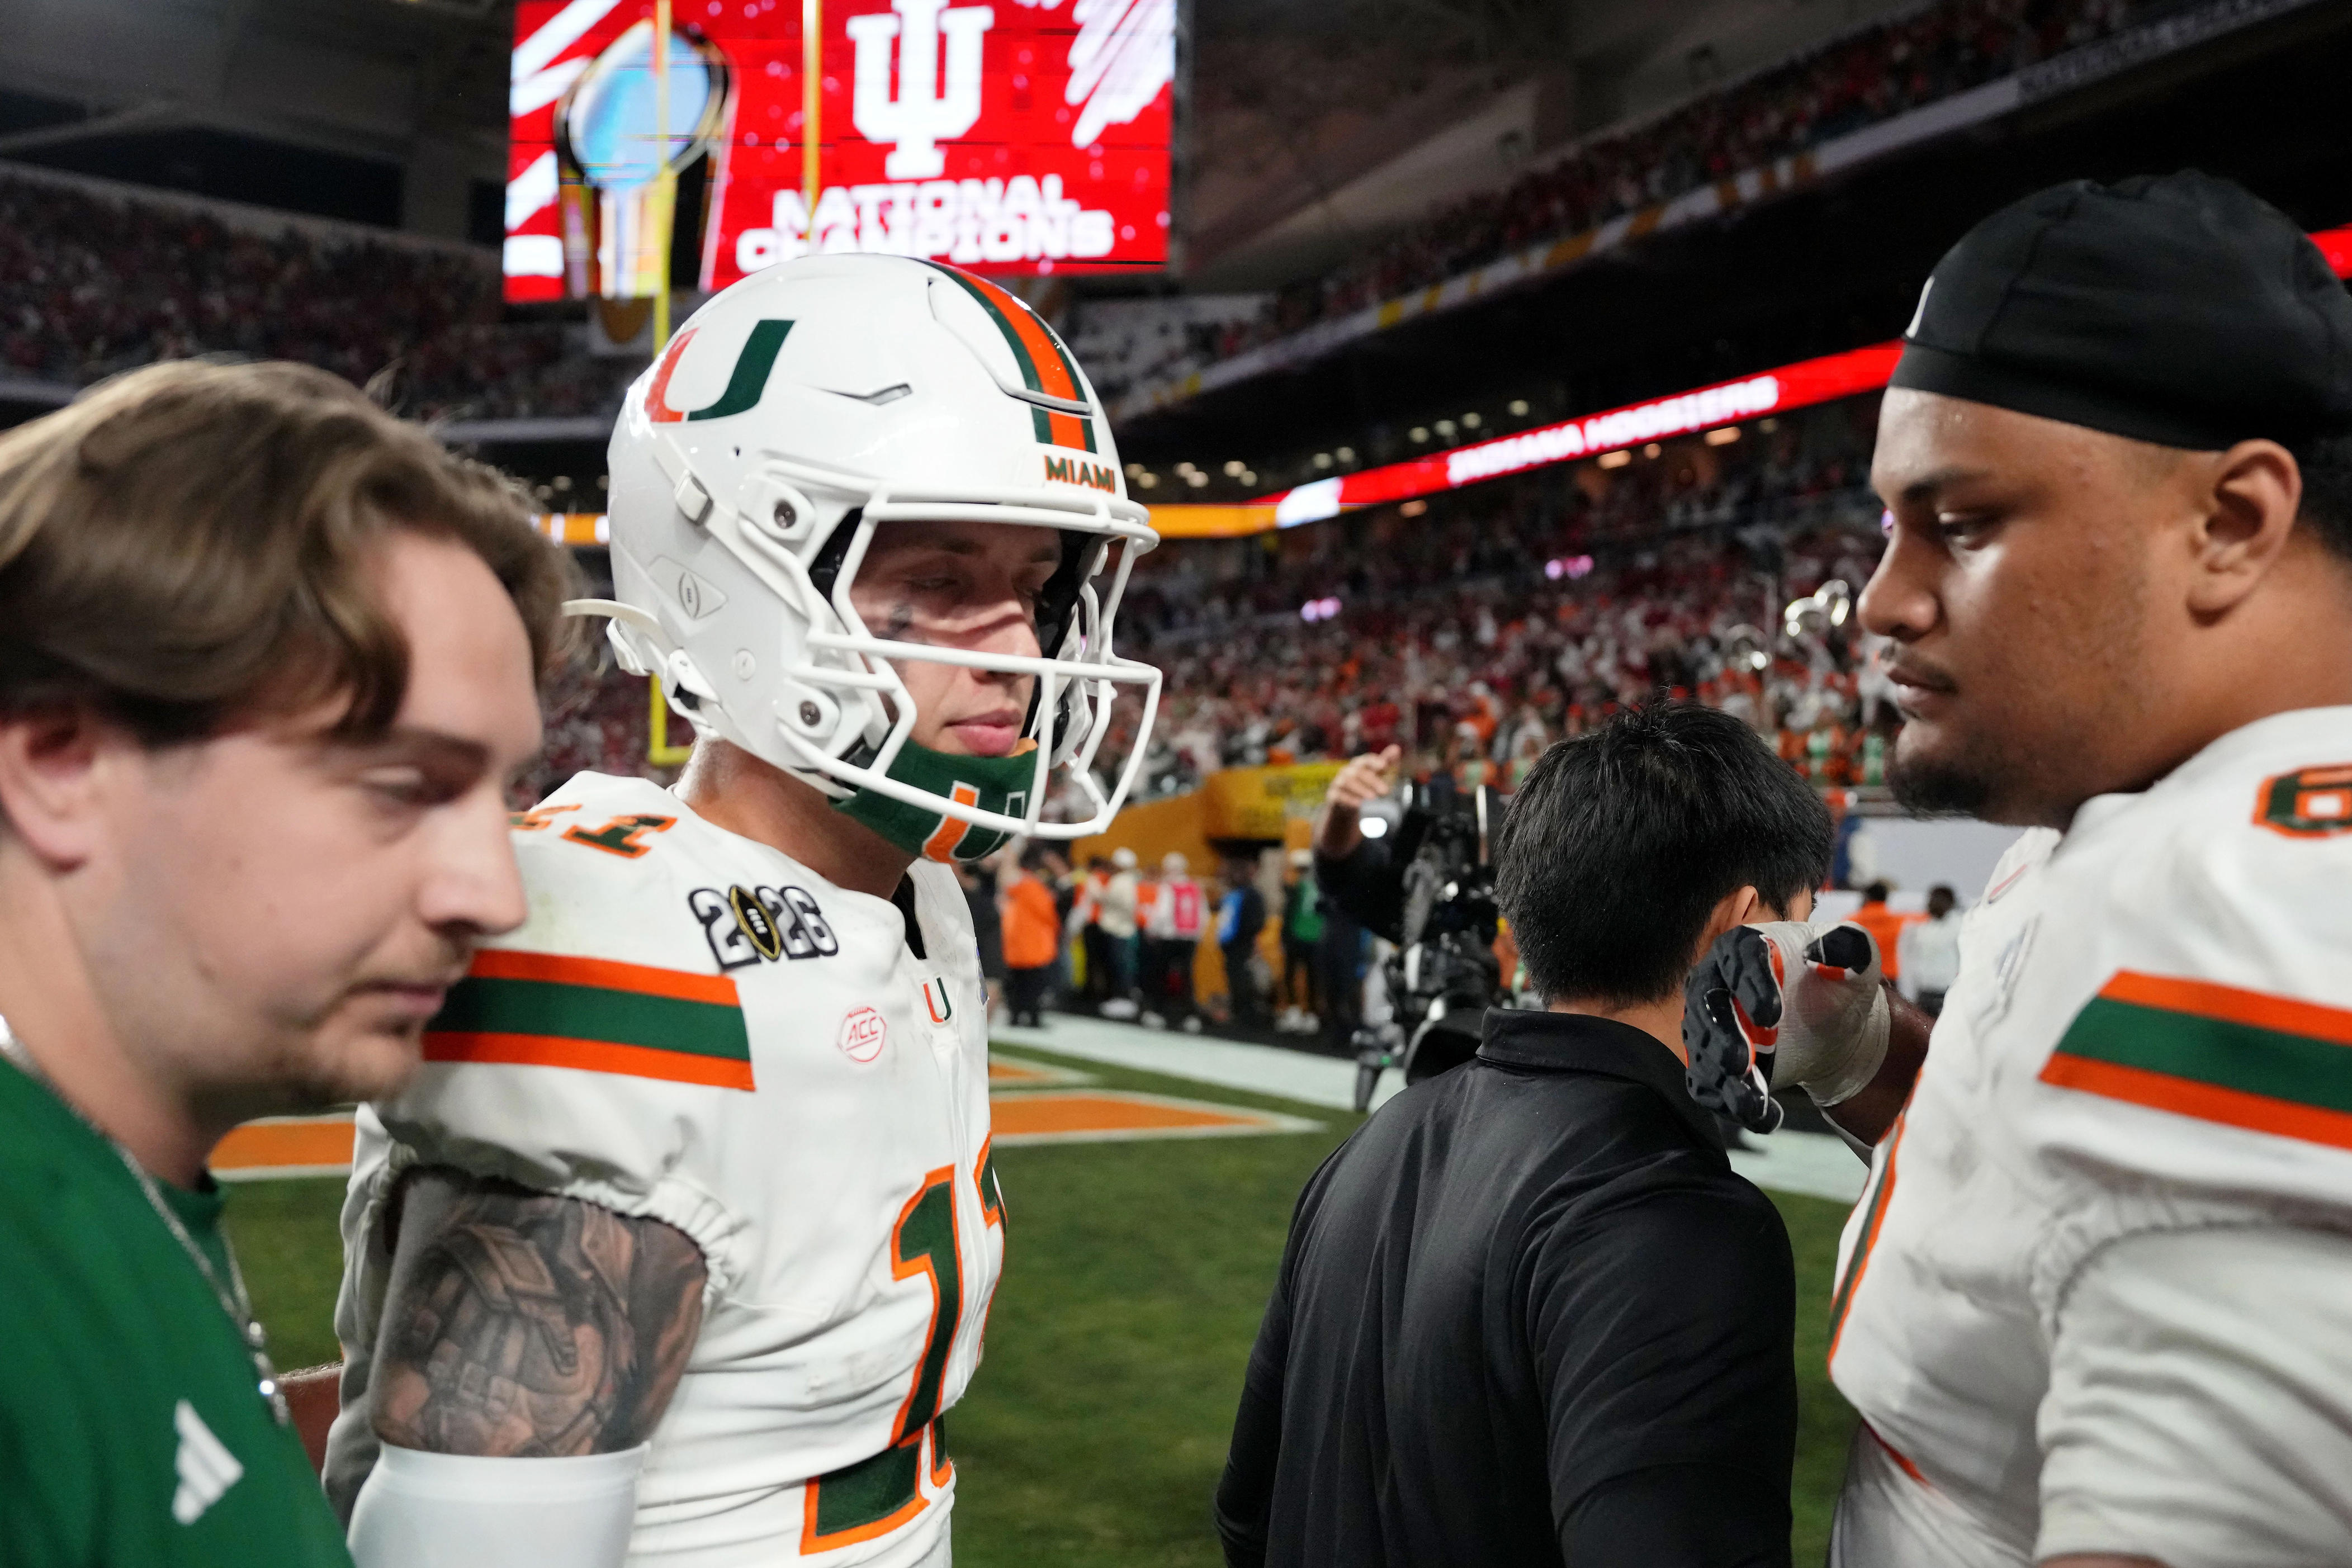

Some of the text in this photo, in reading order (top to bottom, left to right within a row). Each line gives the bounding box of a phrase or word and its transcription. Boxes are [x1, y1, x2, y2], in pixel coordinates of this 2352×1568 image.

[772, 173, 1081, 233] NATIONAL
[736, 210, 1114, 274] CHAMPIONS
[1043, 454, 1116, 494] MIAMI
[688, 884, 838, 973] 2026
[846, 1015, 879, 1044] ACC
